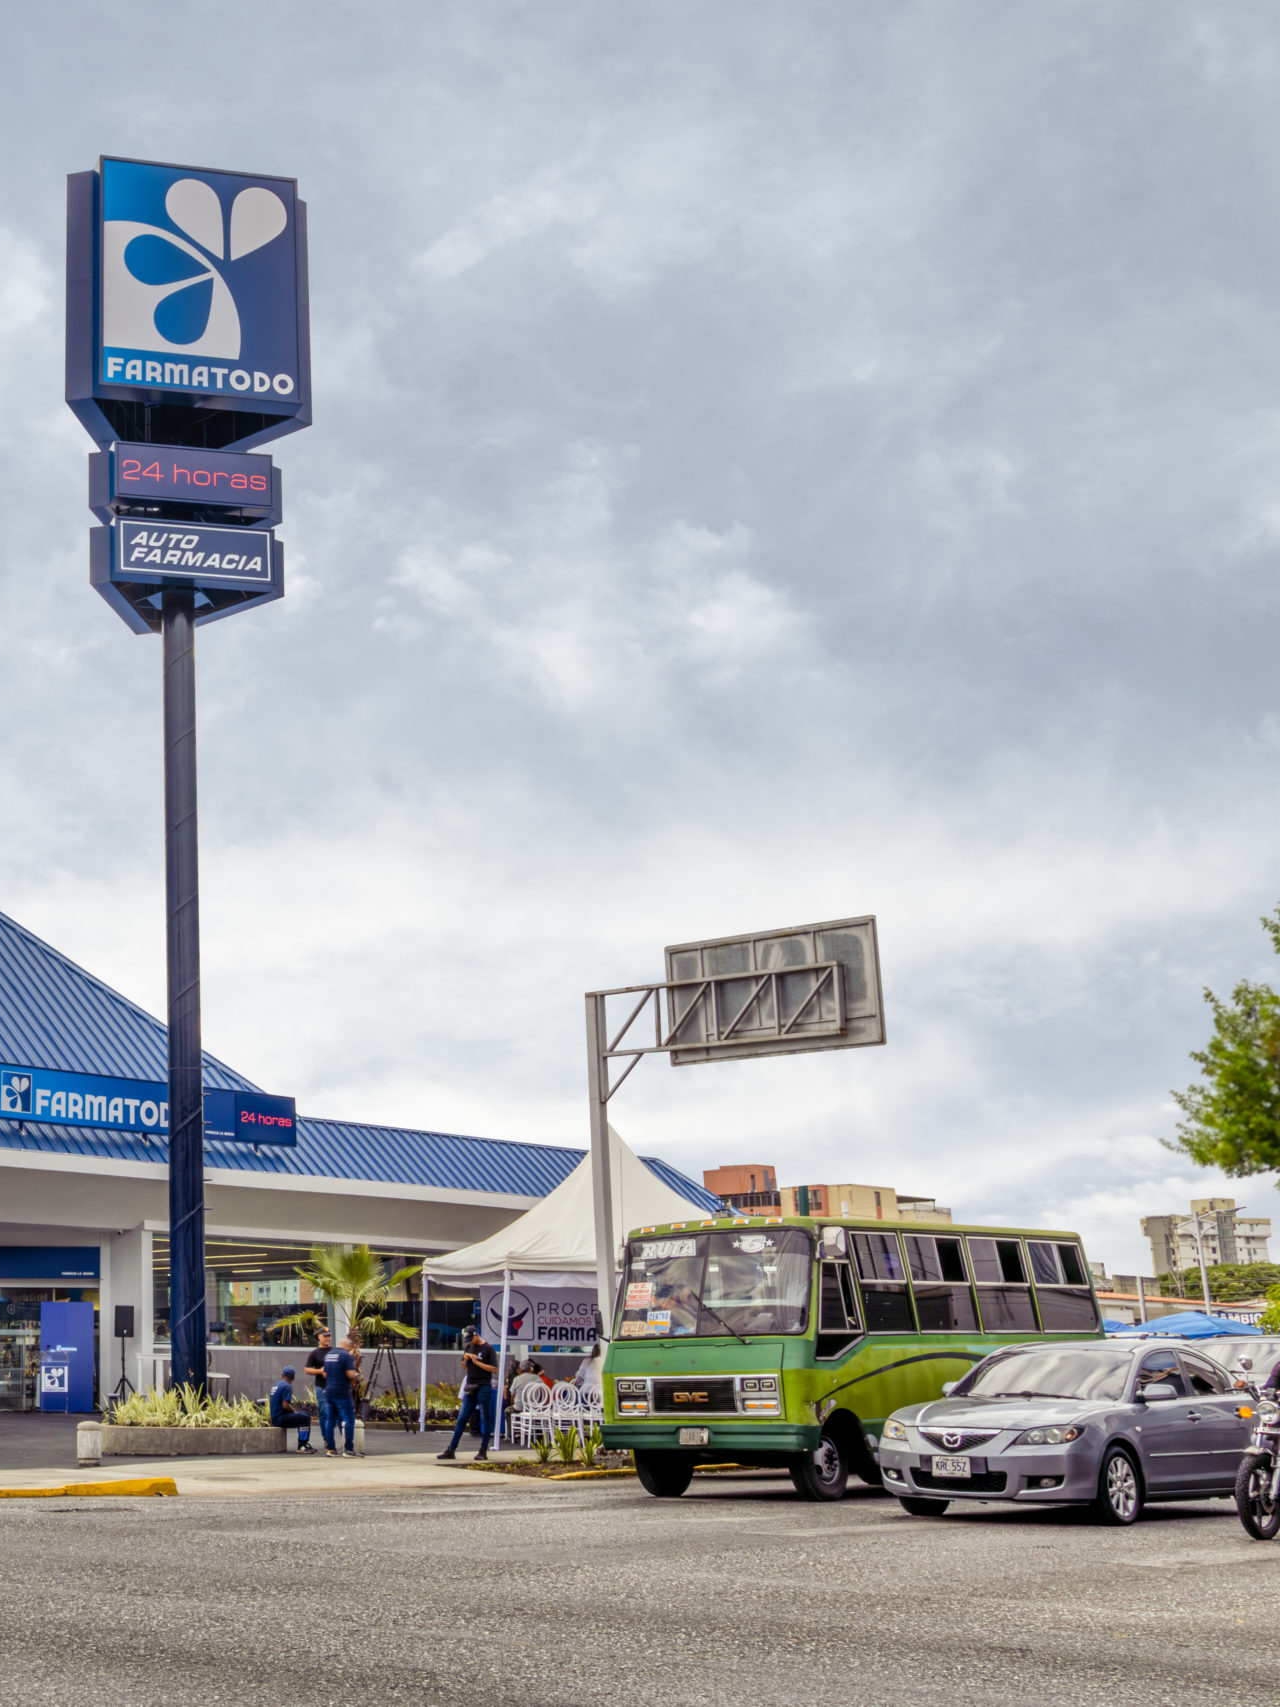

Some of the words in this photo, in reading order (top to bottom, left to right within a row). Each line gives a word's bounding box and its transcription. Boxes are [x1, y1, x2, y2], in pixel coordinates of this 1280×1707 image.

[107, 357, 295, 396] FARMATODO
[123, 459, 164, 483] 24
[173, 464, 266, 491] horas
[130, 531, 199, 551] AUTO
[130, 547, 263, 573] FARMACIA
[35, 1088, 169, 1127] FARMATOD
[240, 1110, 256, 1124] 24
[258, 1112, 292, 1128] horas
[641, 1239, 696, 1259] RUTA
[537, 1316, 592, 1326] CUIDAMOS
[648, 1312, 669, 1321] CENTRO
[538, 1327, 596, 1341] FARMA
[673, 1391, 709, 1403] GMC
[936, 1461, 949, 1471] KRL
